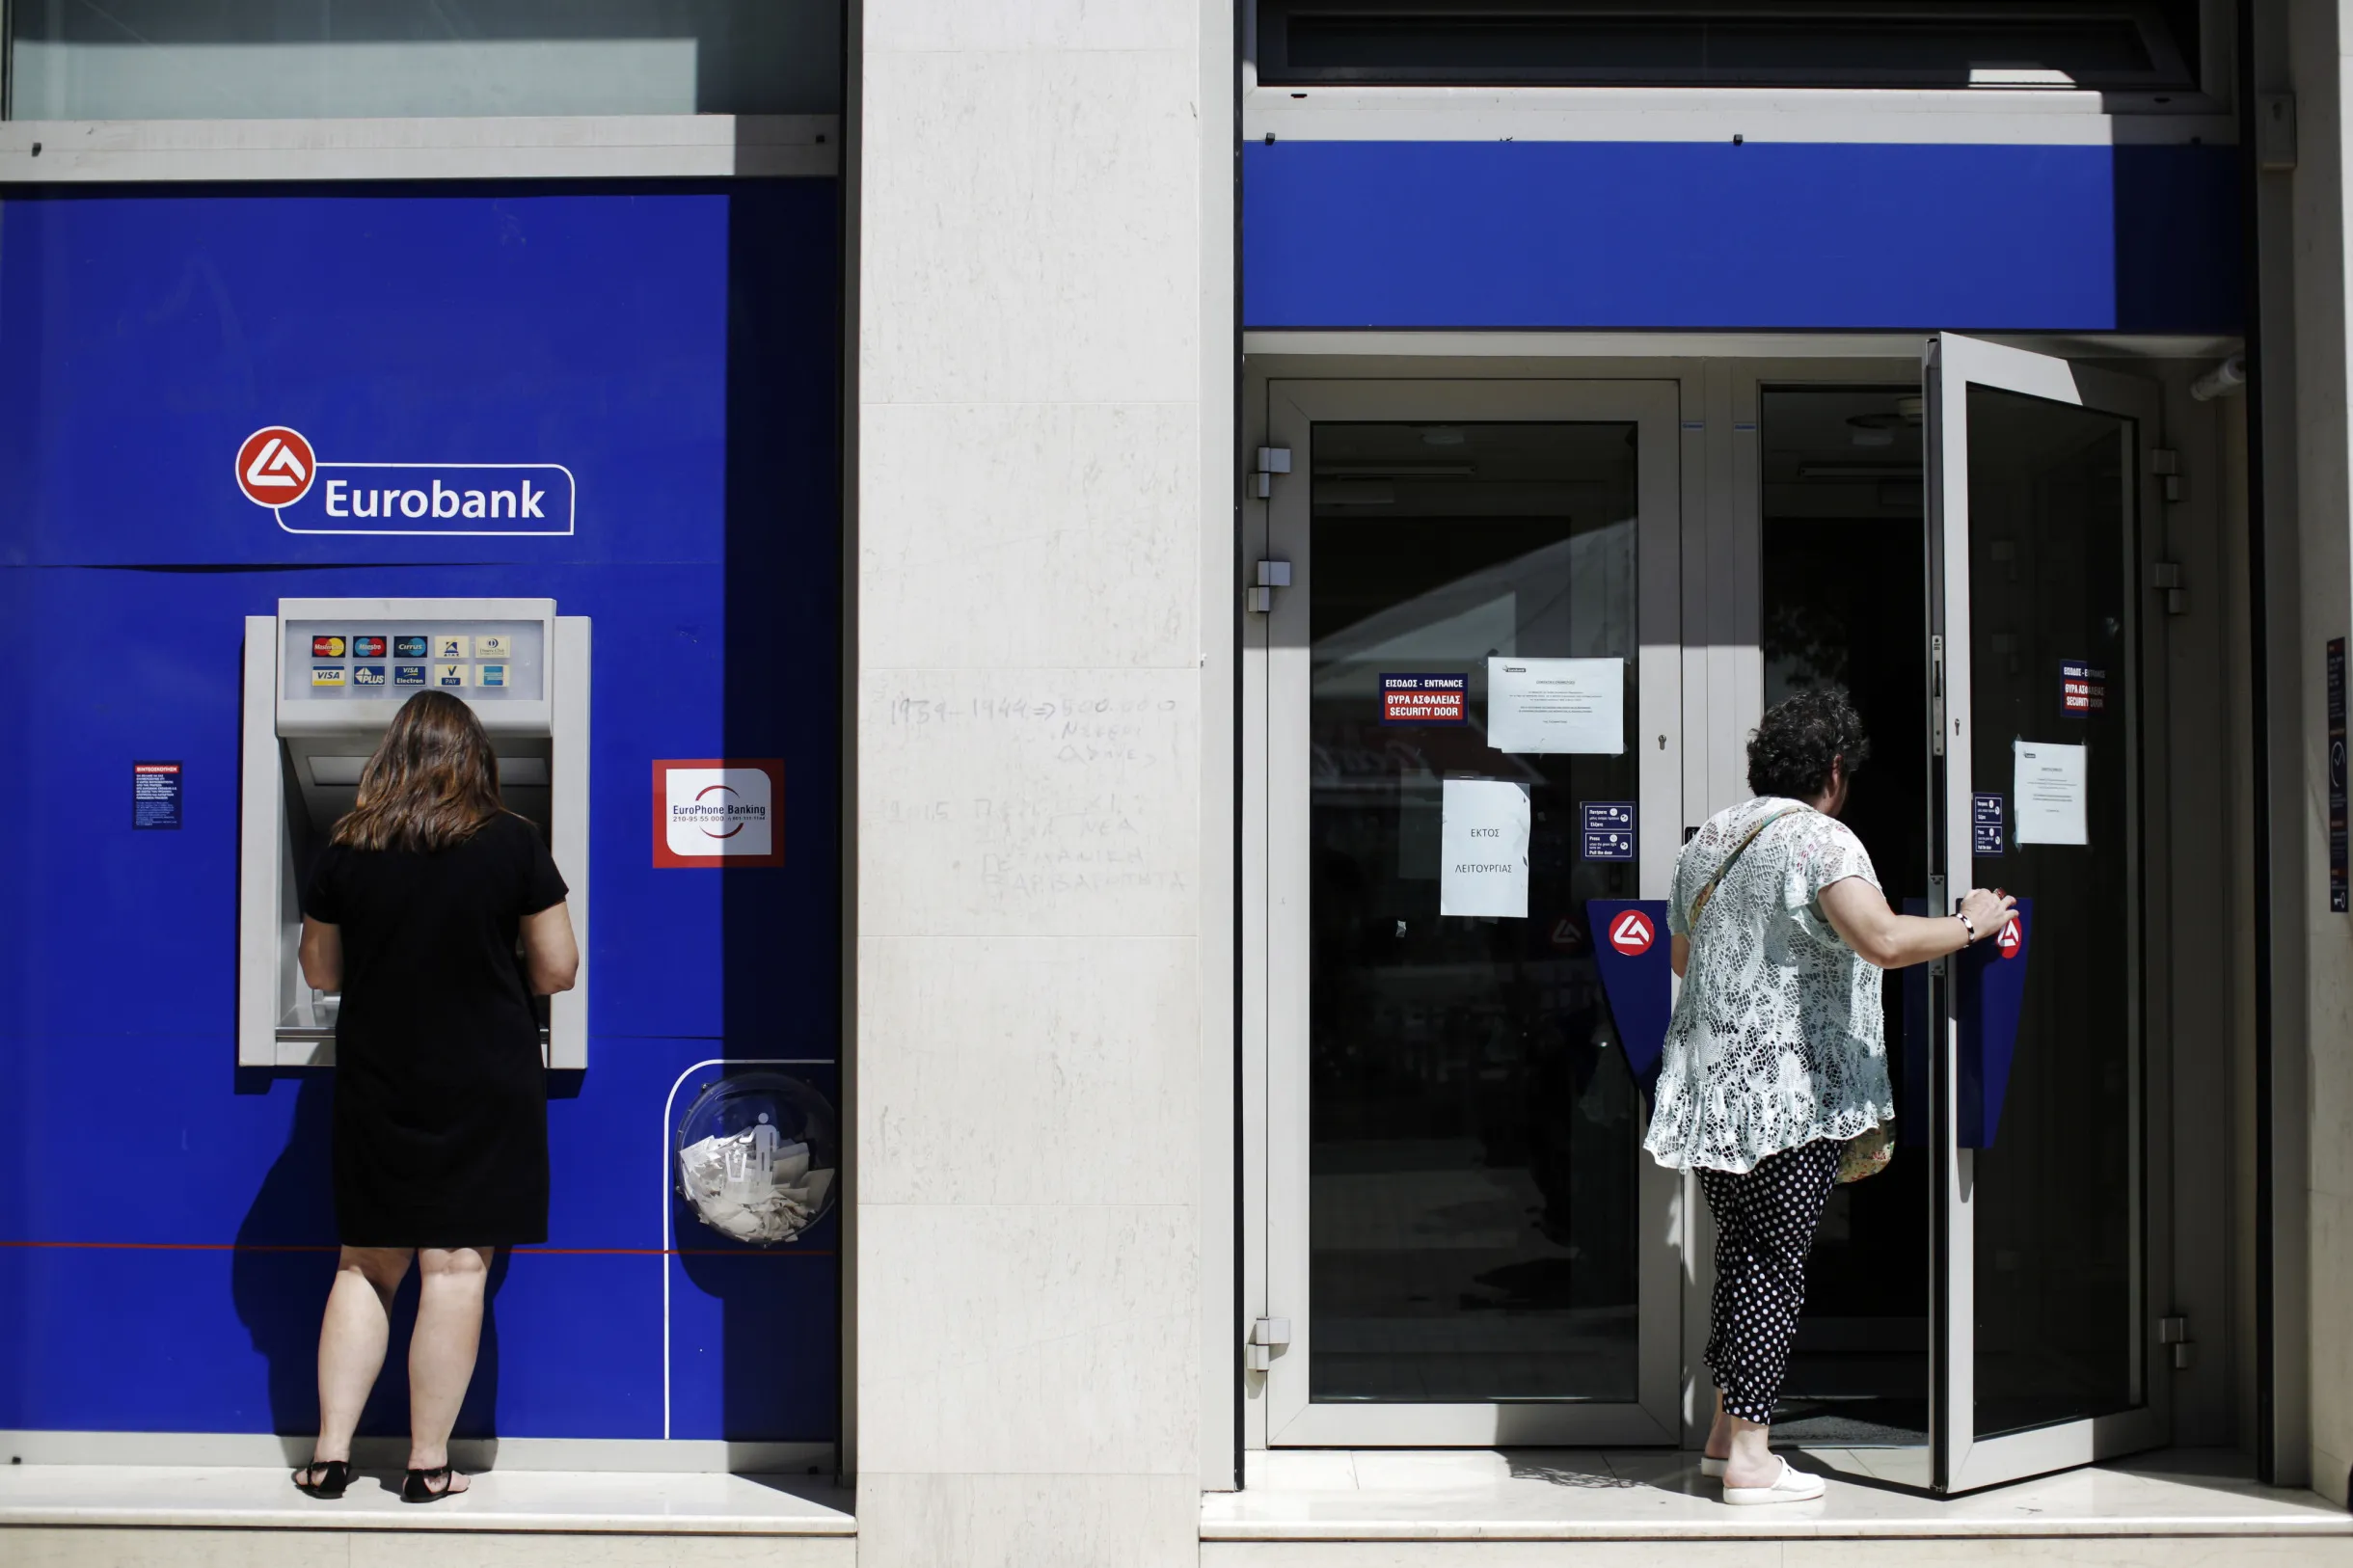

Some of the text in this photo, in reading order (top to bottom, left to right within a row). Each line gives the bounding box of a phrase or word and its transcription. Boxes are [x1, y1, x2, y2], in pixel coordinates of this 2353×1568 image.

[325, 479, 546, 518] Eurobank
[362, 675, 385, 684] PLUS
[1385, 679, 1418, 688] ΕΙΣΟΔΟΣ
[1424, 679, 1463, 688] ENTRANCE
[1387, 694, 1461, 705] ΘΥΡΑ ΑΣΦΑΛΕΙΑΣ
[2067, 696, 2089, 707] SECURITY
[1390, 707, 1458, 716] SECURITY DOOR
[673, 804, 766, 816] EuroPhone Banking
[1471, 828, 1500, 838] ΕΚΤΟΣ
[1454, 864, 1512, 873] ΛΕΙΤΟΥΡΓΙΑΣ
